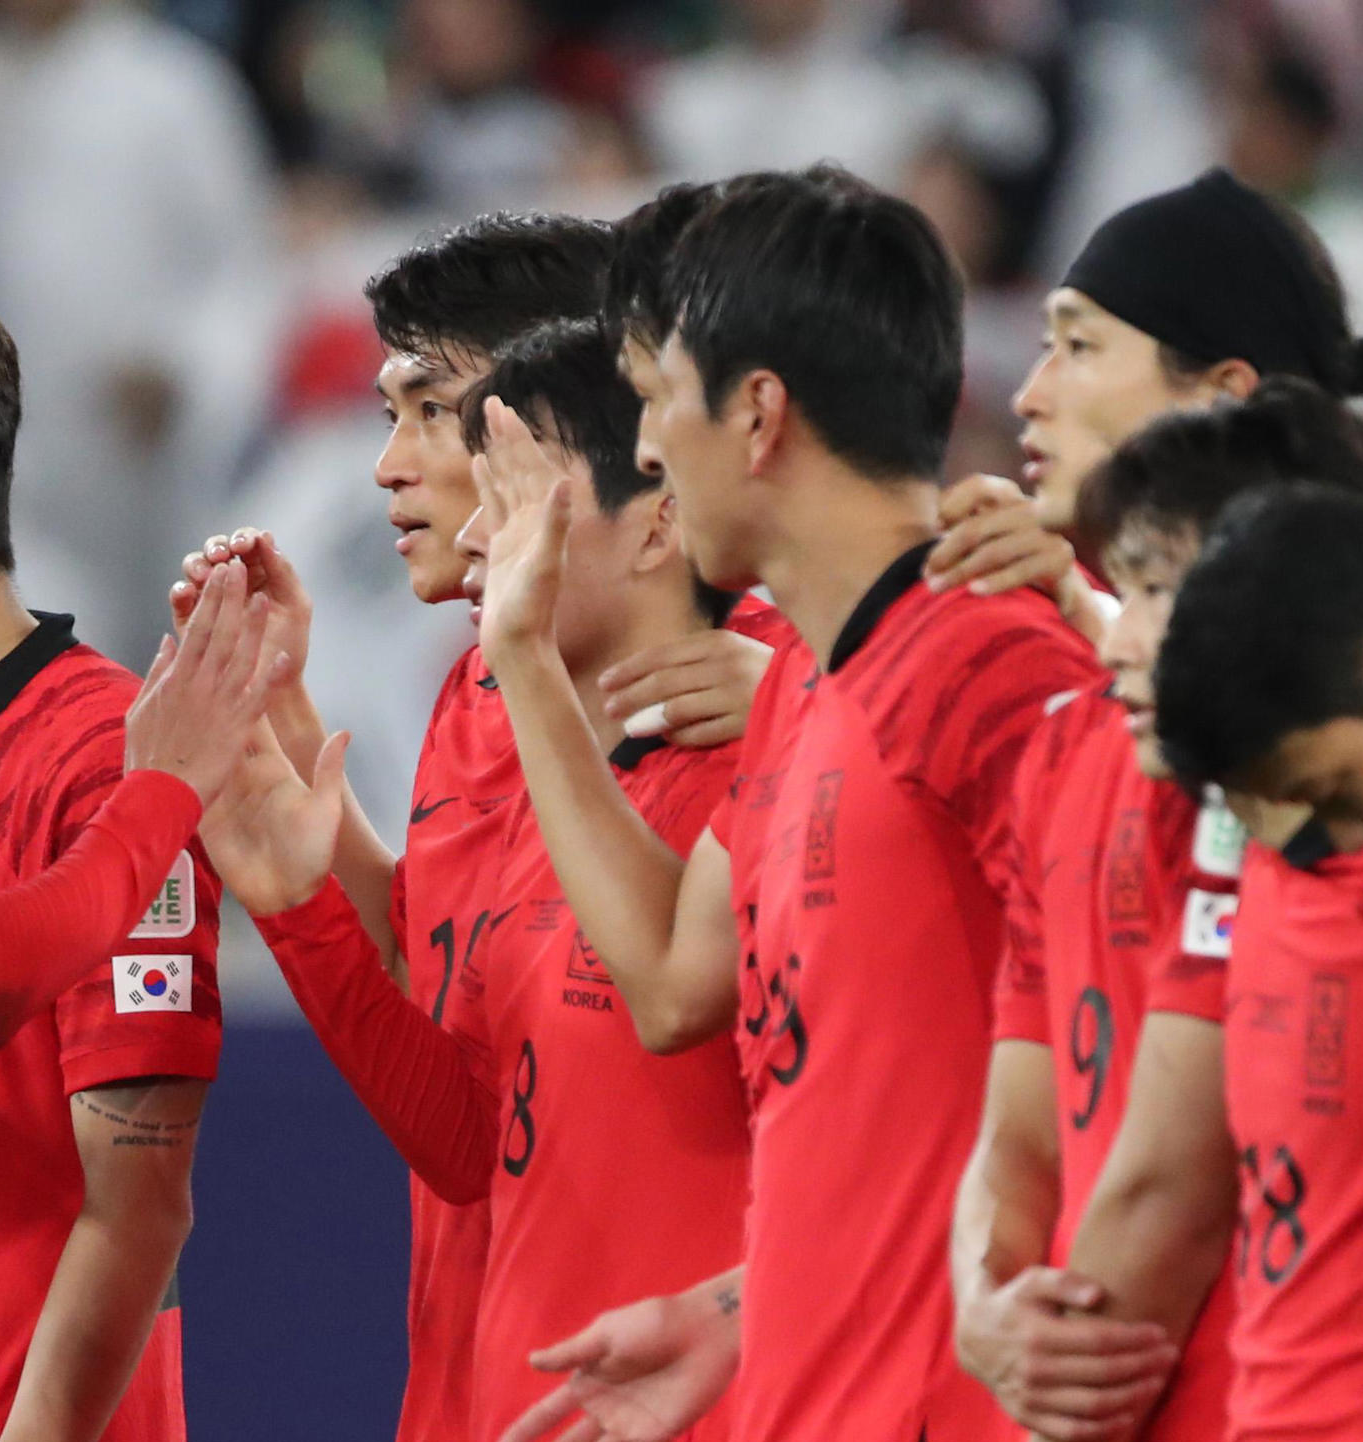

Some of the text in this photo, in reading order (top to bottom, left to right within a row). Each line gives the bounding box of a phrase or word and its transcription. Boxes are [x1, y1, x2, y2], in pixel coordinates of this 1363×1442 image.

[563, 989, 614, 1012] KOREA
[1070, 986, 1114, 1130] 9
[503, 1038, 536, 1178] 8
